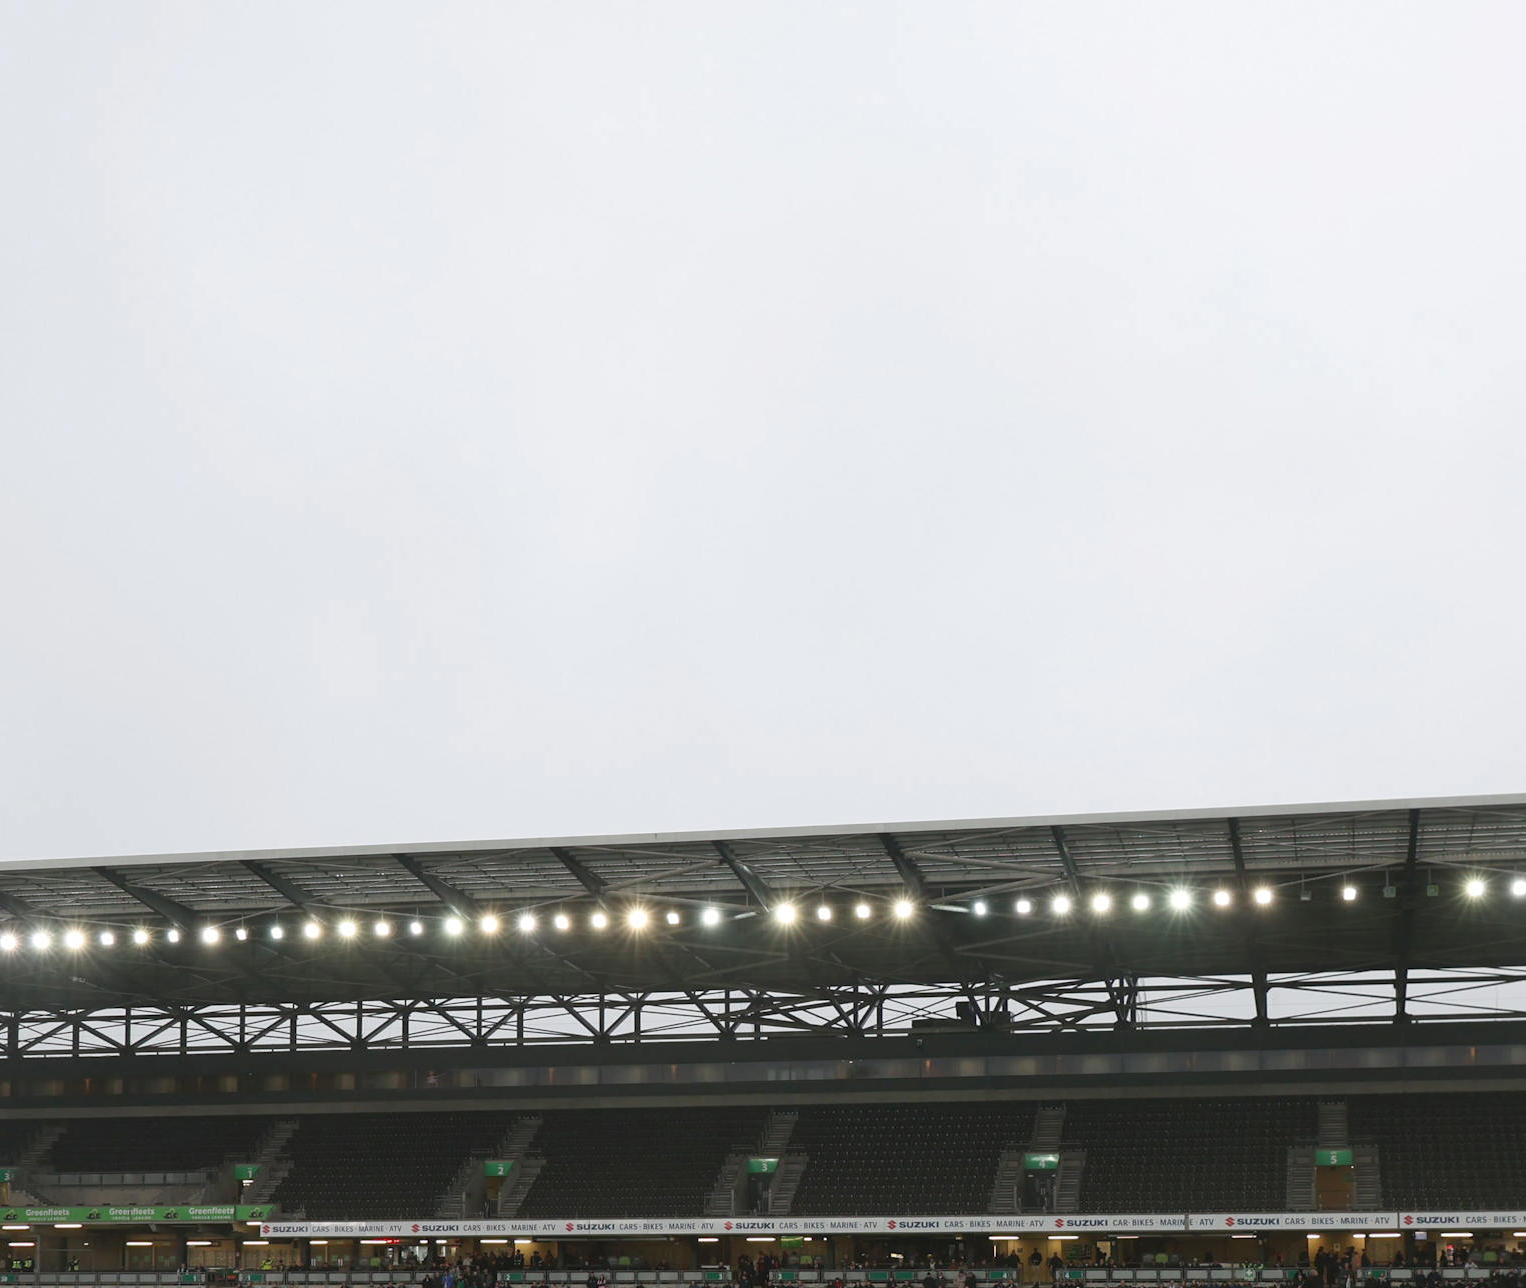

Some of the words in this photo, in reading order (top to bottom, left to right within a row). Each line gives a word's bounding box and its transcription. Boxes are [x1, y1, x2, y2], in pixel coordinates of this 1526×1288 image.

[1331, 1155, 1337, 1164] 5
[498, 1166, 504, 1175] 2
[762, 1162, 767, 1171] 3
